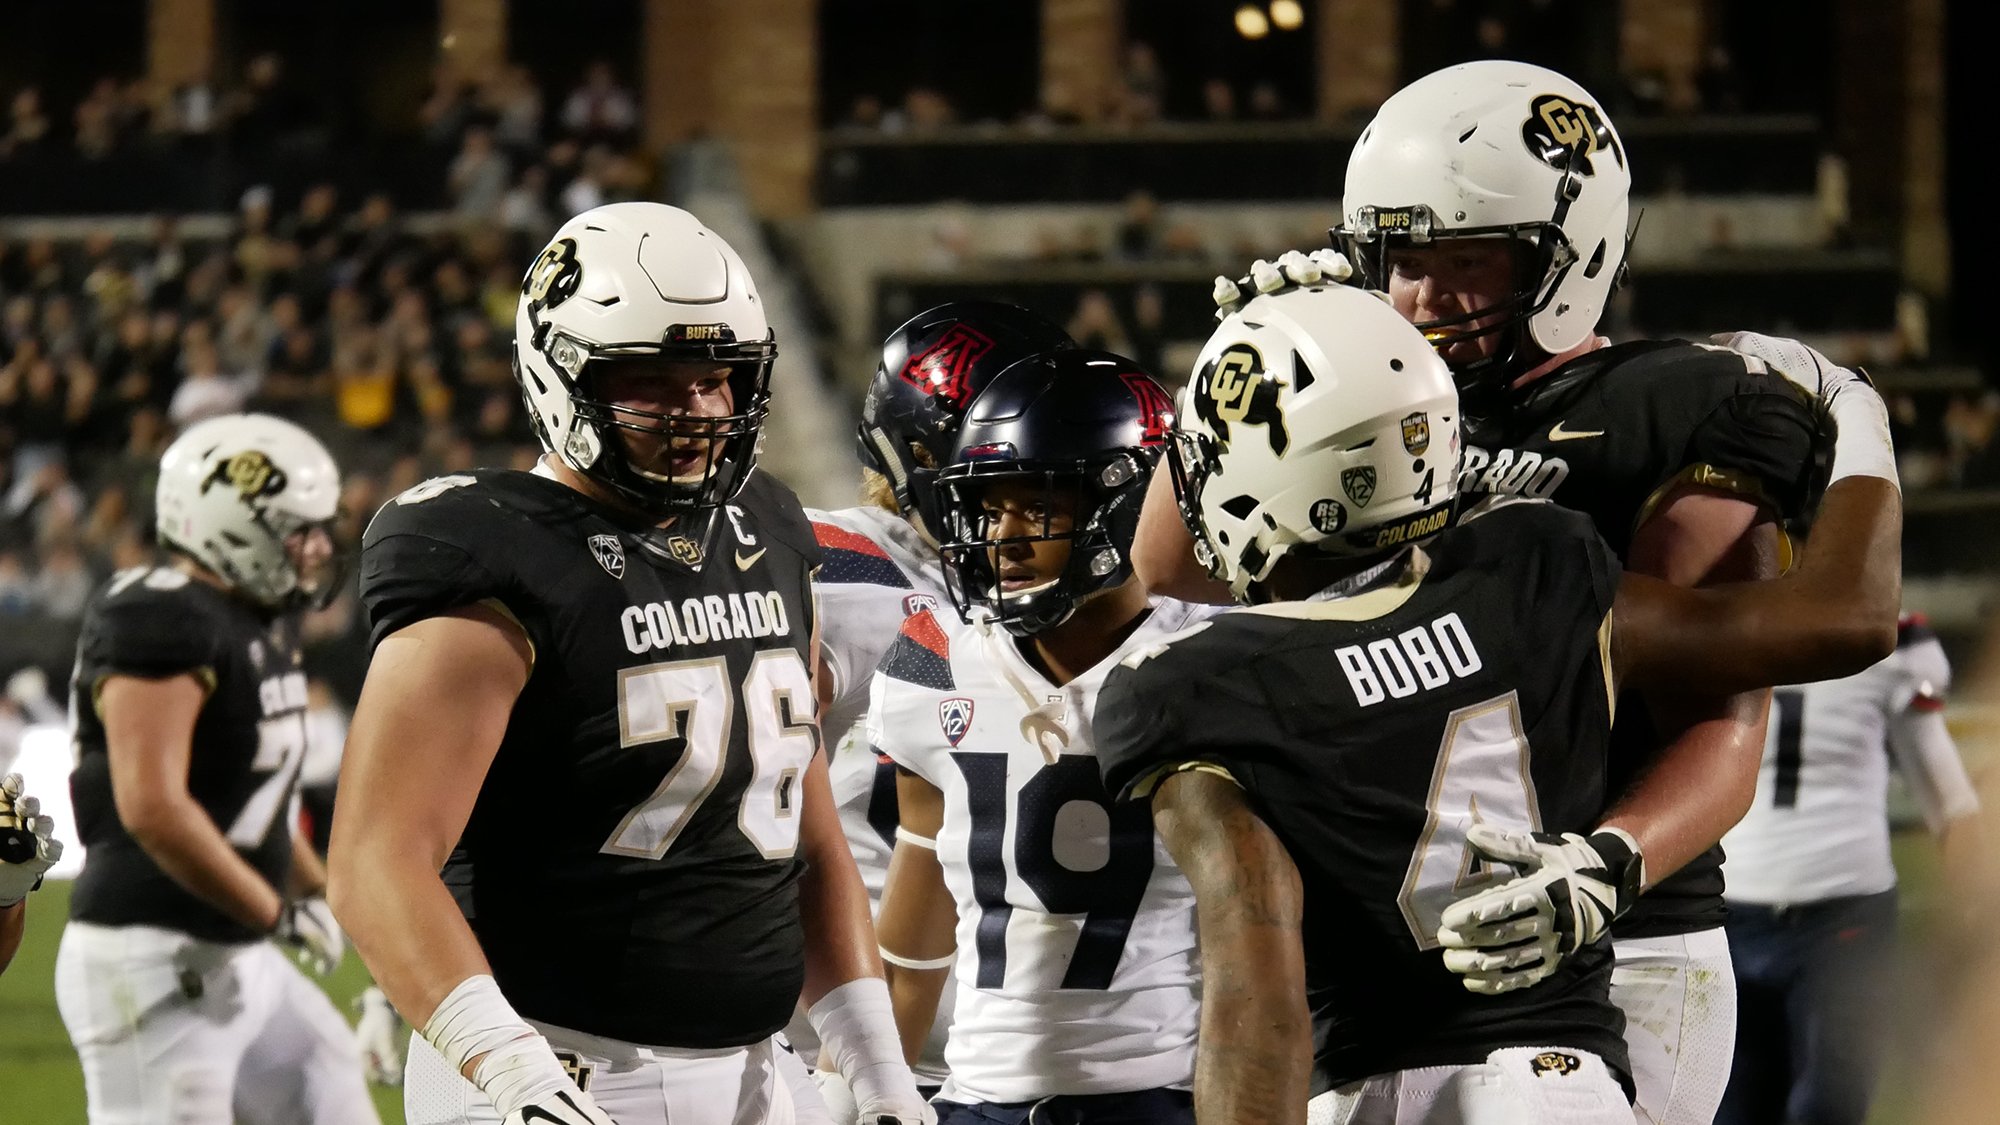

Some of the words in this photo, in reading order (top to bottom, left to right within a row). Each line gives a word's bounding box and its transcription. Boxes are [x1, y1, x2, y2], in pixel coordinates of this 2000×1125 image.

[1379, 212, 1410, 228] BUFFS
[686, 326, 721, 340] BUFFS
[1342, 466, 1376, 493] PAC
[1413, 467, 1435, 506] 4
[1457, 445, 1570, 499] RADO
[1352, 484, 1370, 500] 12
[1316, 502, 1340, 517] RS
[725, 505, 757, 546] C
[1320, 517, 1339, 532] 19
[1375, 508, 1450, 548] COLORADO
[589, 536, 623, 562] PAC
[603, 552, 623, 571] 12
[621, 591, 790, 655] COLORADO
[1335, 612, 1483, 707] BOBO
[940, 699, 972, 728] PAC
[946, 718, 964, 736] 12
[598, 647, 820, 860] 76
[1397, 689, 1545, 951] 4
[949, 751, 1156, 989] 19
